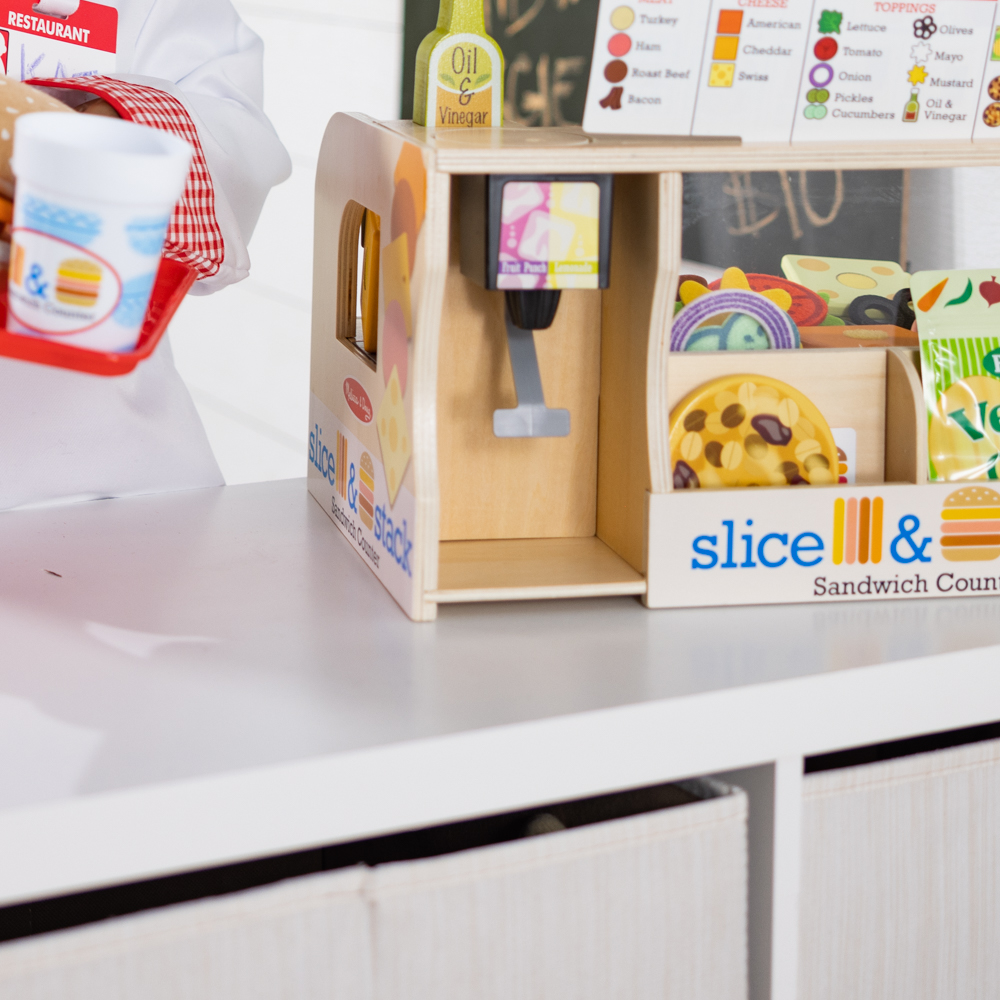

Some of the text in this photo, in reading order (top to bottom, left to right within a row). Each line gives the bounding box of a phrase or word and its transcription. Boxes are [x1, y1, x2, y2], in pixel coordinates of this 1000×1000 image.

[874, 1, 936, 14] TOPPINGS
[640, 14, 678, 26] Turkey
[747, 18, 801, 29] American
[7, 10, 90, 44] RESTAURANT
[847, 21, 887, 33] Lettuce
[940, 25, 973, 36] Olives
[636, 41, 661, 51] Ham
[743, 44, 792, 56] Cheddar
[843, 46, 882, 57] Tomato
[451, 46, 477, 75] Oil
[934, 51, 963, 62] Mayo
[632, 68, 690, 79] Roast Beef
[738, 72, 769, 82] Swiss
[839, 72, 871, 82] Onion
[930, 77, 973, 88] Mustard
[628, 95, 661, 105] Bacon
[834, 93, 873, 103] Pickles
[926, 99, 952, 108] Oil &
[439, 106, 488, 127] Vinegar
[832, 108, 895, 119] Cucumbers
[924, 110, 967, 123] Vinegar
[24, 263, 49, 299] &
[309, 423, 412, 578] slice & stack
[331, 496, 380, 569] Sandwich Counter
[691, 514, 932, 570] slice &
[813, 574, 928, 596] Sandwich
